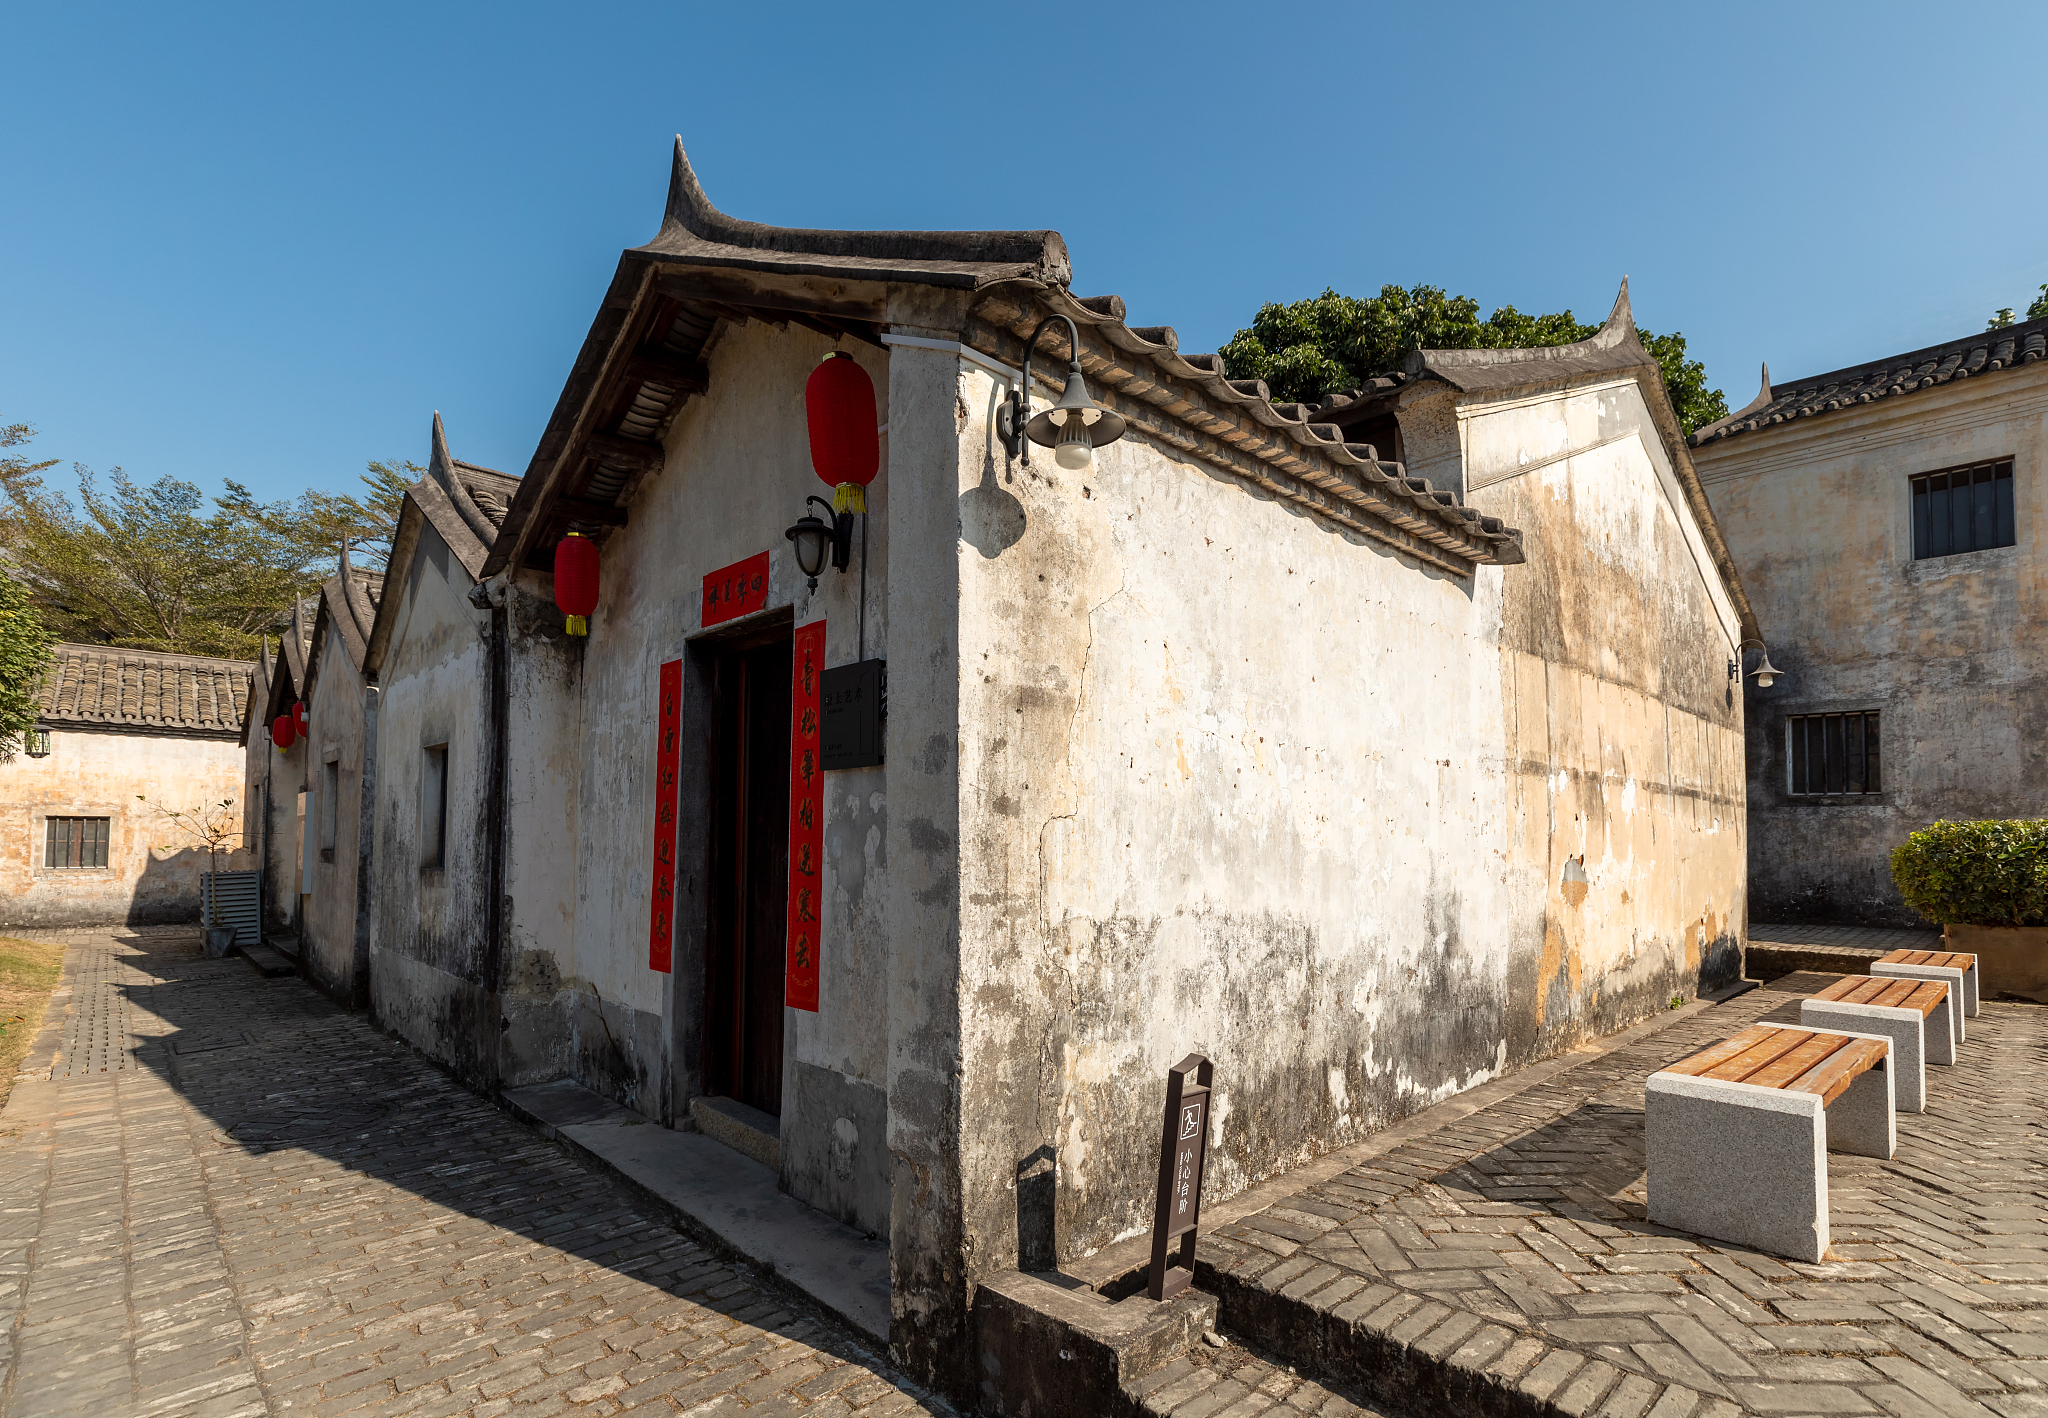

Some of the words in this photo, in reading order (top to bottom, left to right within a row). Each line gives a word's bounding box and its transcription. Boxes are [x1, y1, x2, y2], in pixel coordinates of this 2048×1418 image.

[824, 687, 863, 707] 版上艺术
[1178, 1148, 1192, 1214] 小心台阶
